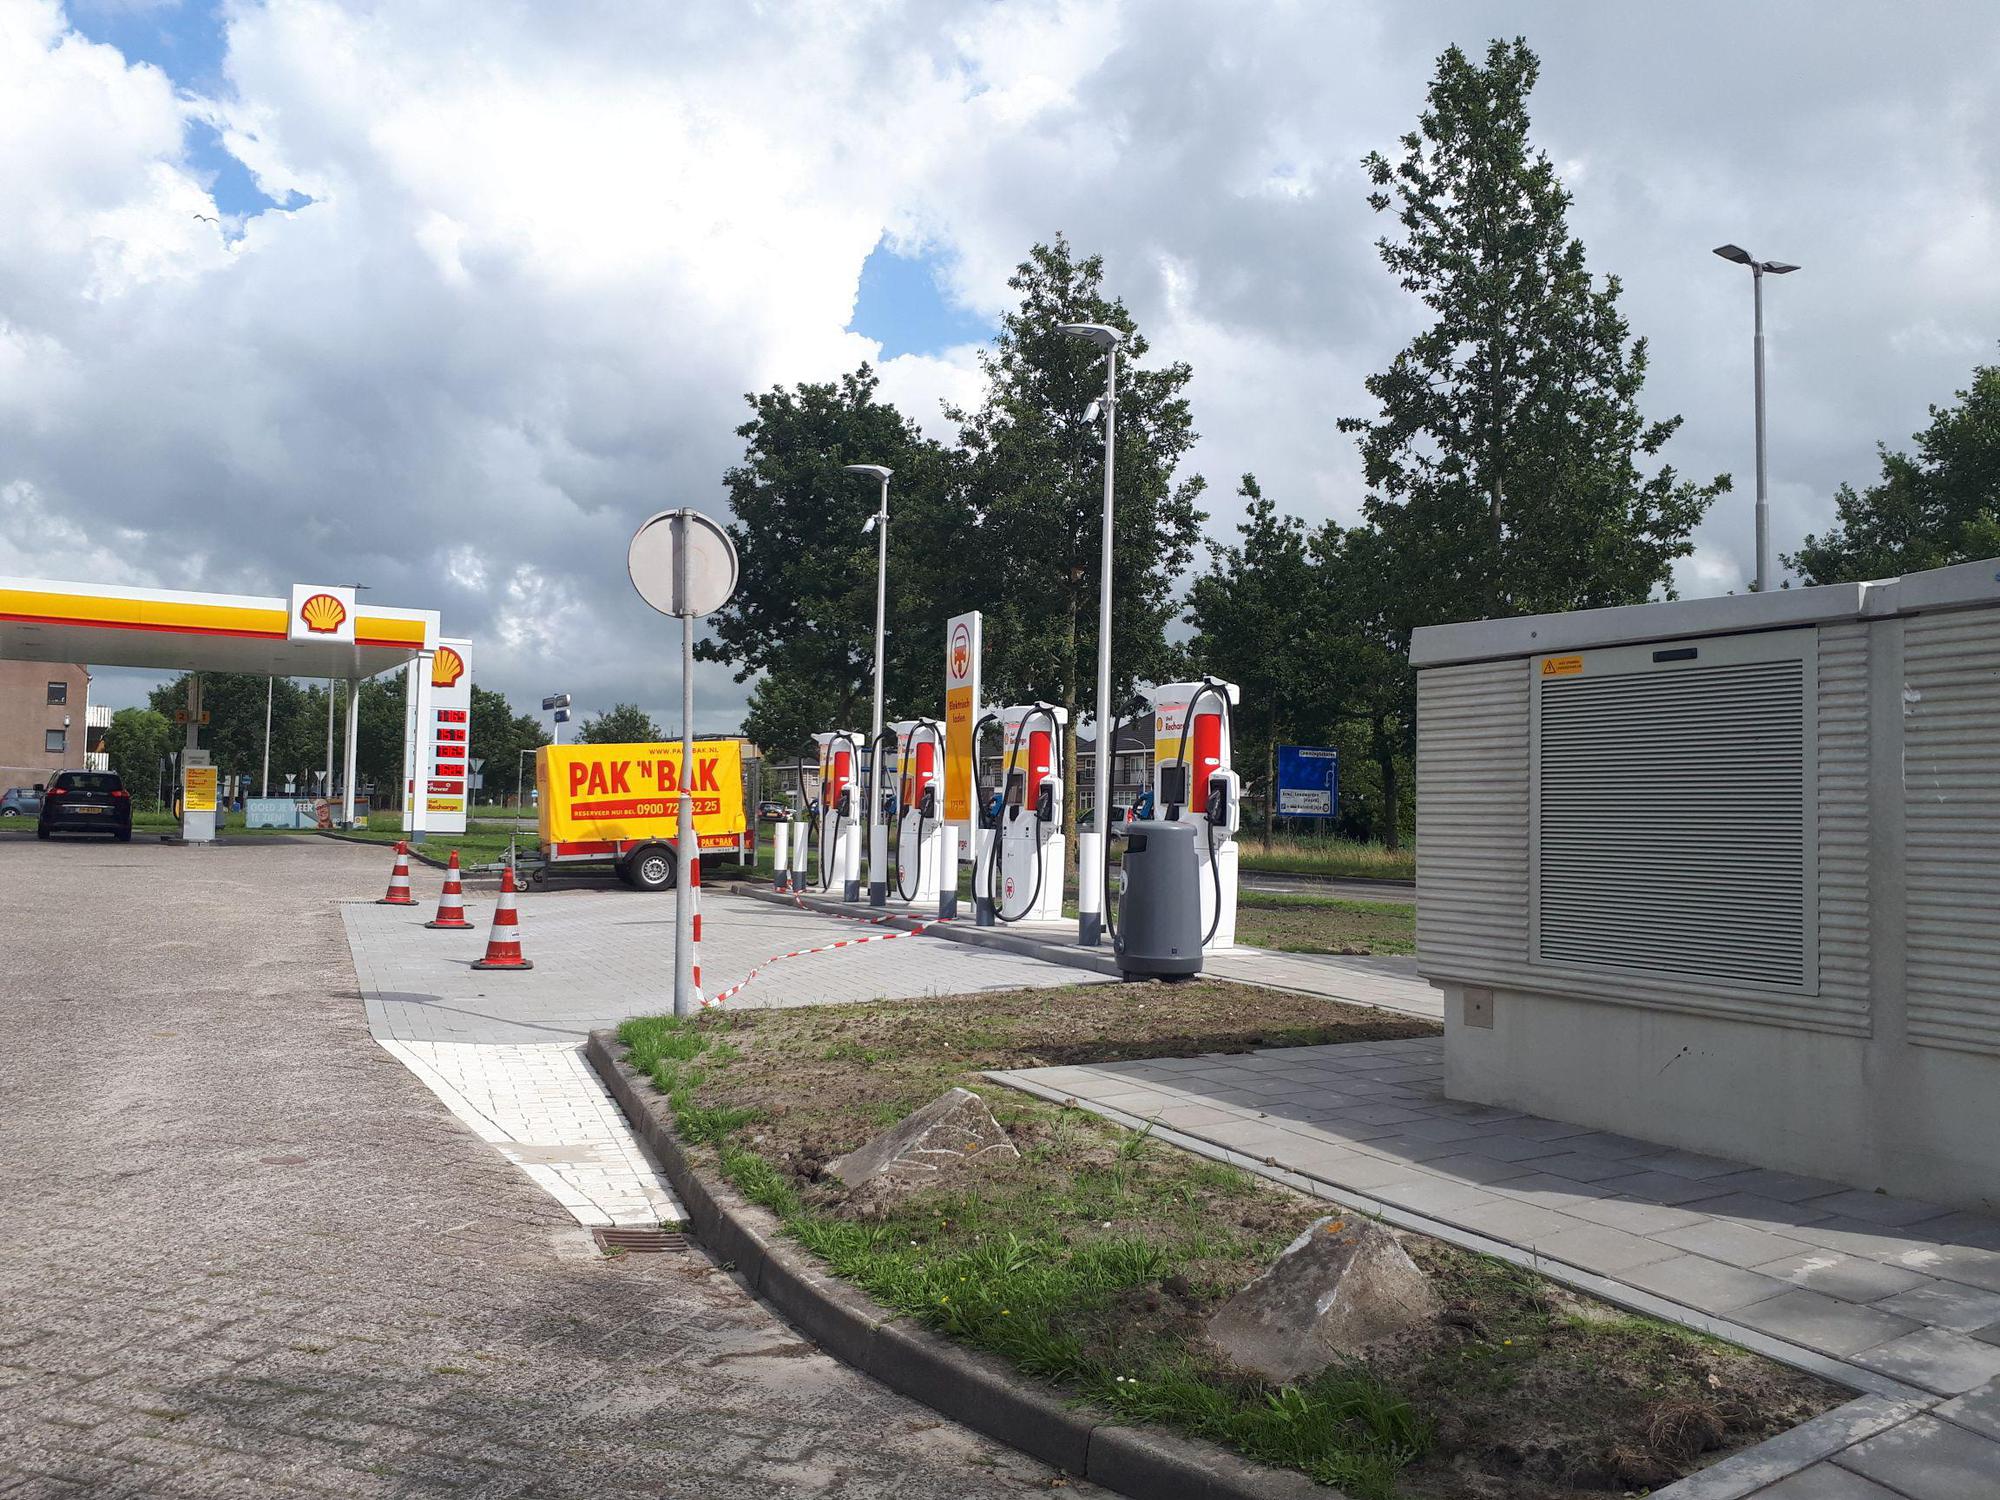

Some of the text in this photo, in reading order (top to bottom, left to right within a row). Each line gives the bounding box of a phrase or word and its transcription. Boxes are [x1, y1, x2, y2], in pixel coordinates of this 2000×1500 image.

[1166, 721, 1184, 730] Rechar
[649, 747, 719, 755] WWW.PABAK.NL
[569, 760, 632, 797] PAK
[290, 803, 314, 812] WEER
[637, 803, 664, 815] 0900
[666, 802, 680, 814] 72
[705, 800, 718, 811] 25
